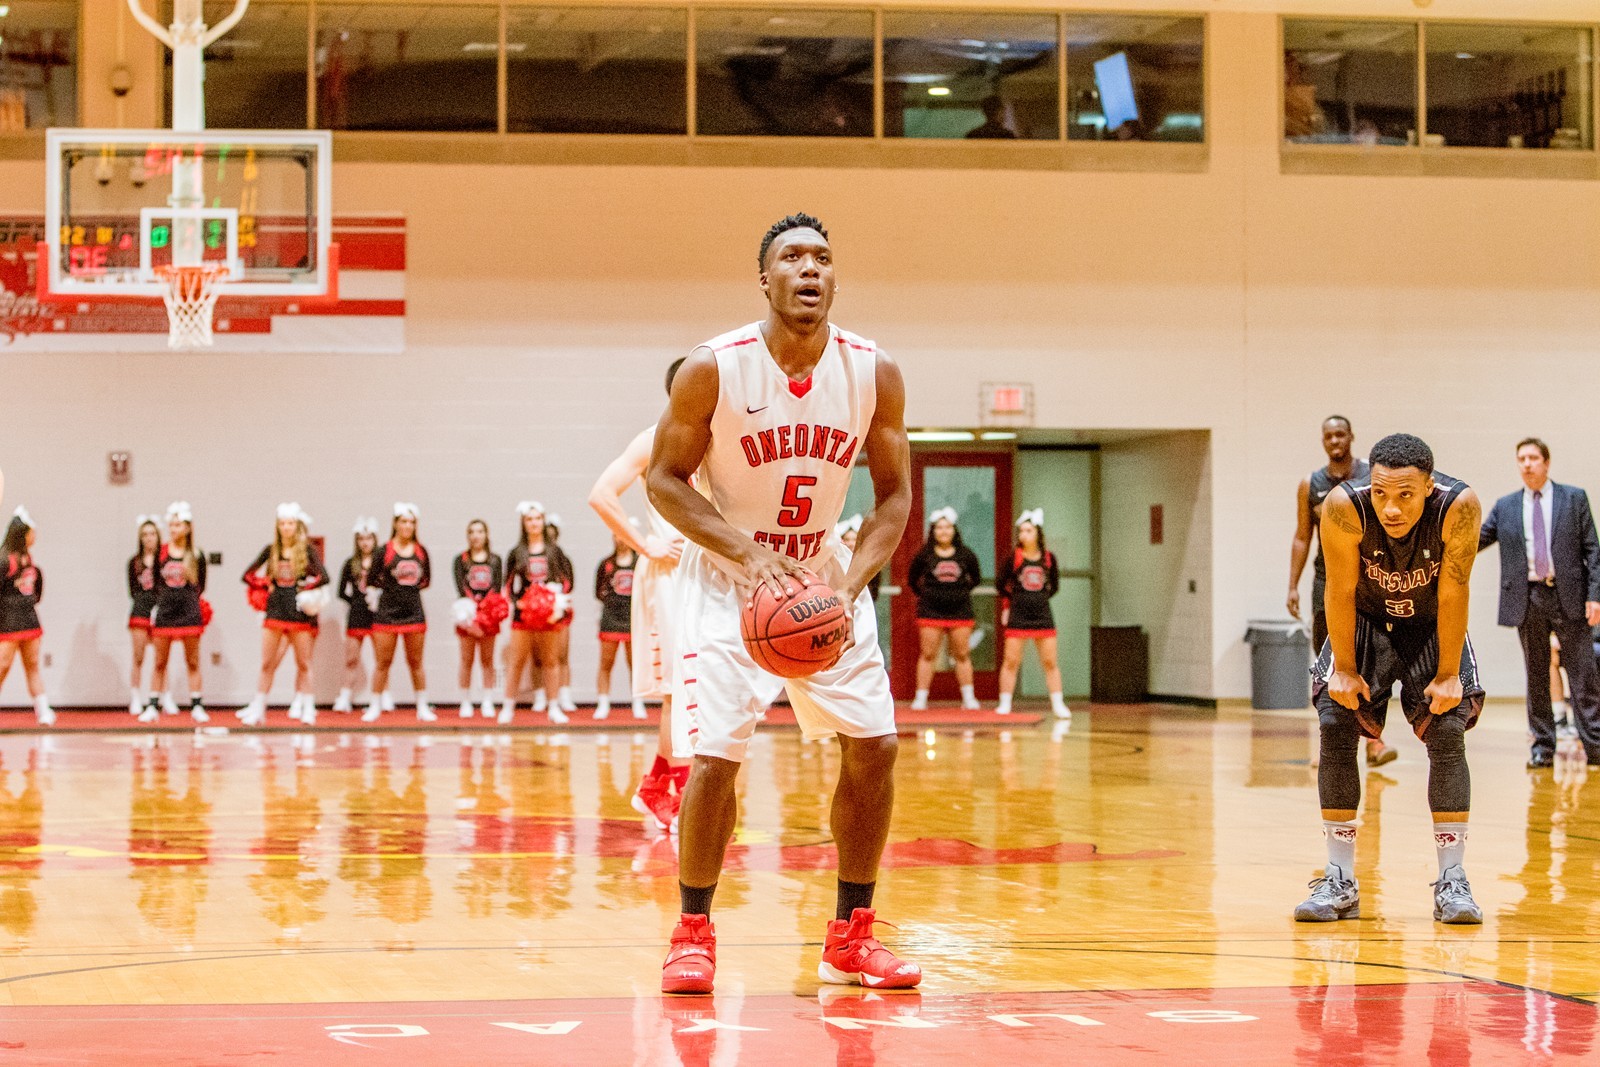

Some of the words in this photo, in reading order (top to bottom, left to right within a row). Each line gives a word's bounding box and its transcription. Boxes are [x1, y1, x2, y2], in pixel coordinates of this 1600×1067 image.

[740, 423, 858, 468] ONEONTA
[777, 475, 817, 527] 5
[1385, 599, 1415, 617] 3
